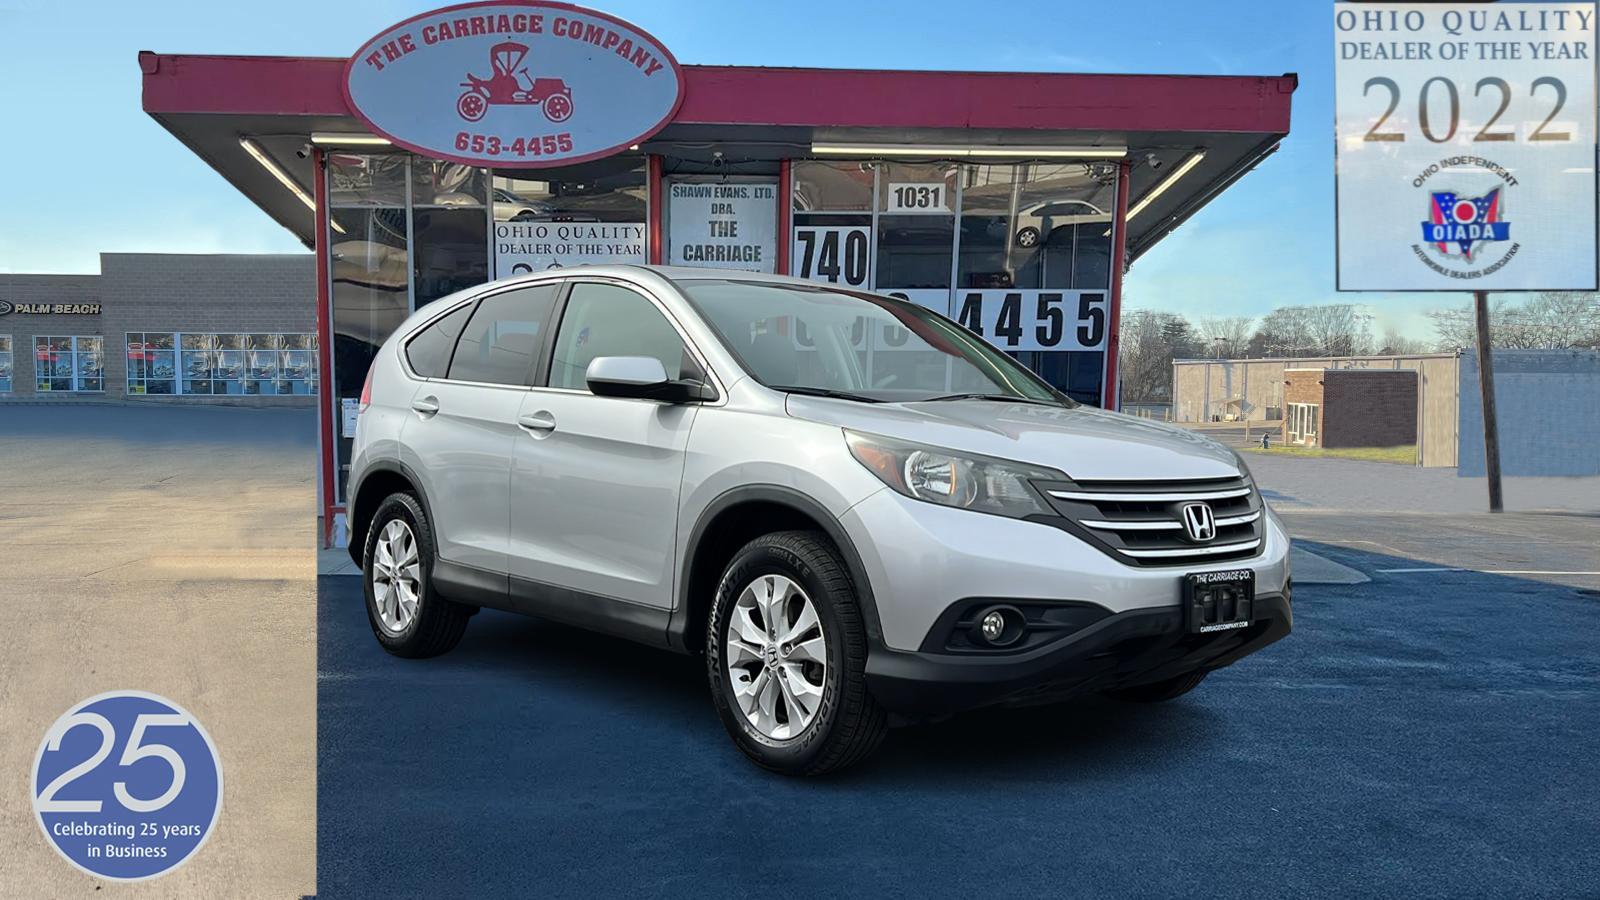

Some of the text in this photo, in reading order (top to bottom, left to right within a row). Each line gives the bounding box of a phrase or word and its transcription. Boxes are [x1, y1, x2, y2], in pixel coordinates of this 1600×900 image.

[1336, 10, 1593, 35] OHIO QUALITY
[366, 14, 664, 77] THE CARRIAGE COMPANY
[1340, 42, 1589, 60] DEALER OF THE YEAR
[1363, 76, 1571, 143] 2022
[455, 131, 573, 156] 653-4455
[1412, 155, 1519, 188] OHIO INDEPENDENT
[672, 185, 713, 199] SHAWN
[754, 187, 775, 199] LTD.
[894, 186, 941, 209] 1031
[711, 203, 736, 216] DBA.
[497, 225, 645, 241] OHIO QUALITY
[708, 220, 738, 238] THE
[1433, 223, 1495, 240] OIADA
[499, 243, 641, 255] DEALER OF THE YEAR
[683, 244, 762, 262] CARRIAGE
[797, 230, 868, 286] 740
[1411, 242, 1521, 280] AUTOMOBILE DEALERS ASSOCIATION
[15, 303, 51, 314] PALM
[54, 303, 100, 314] BEACH
[1196, 574, 1208, 584] THE
[1208, 571, 1239, 582] CARRIAGE
